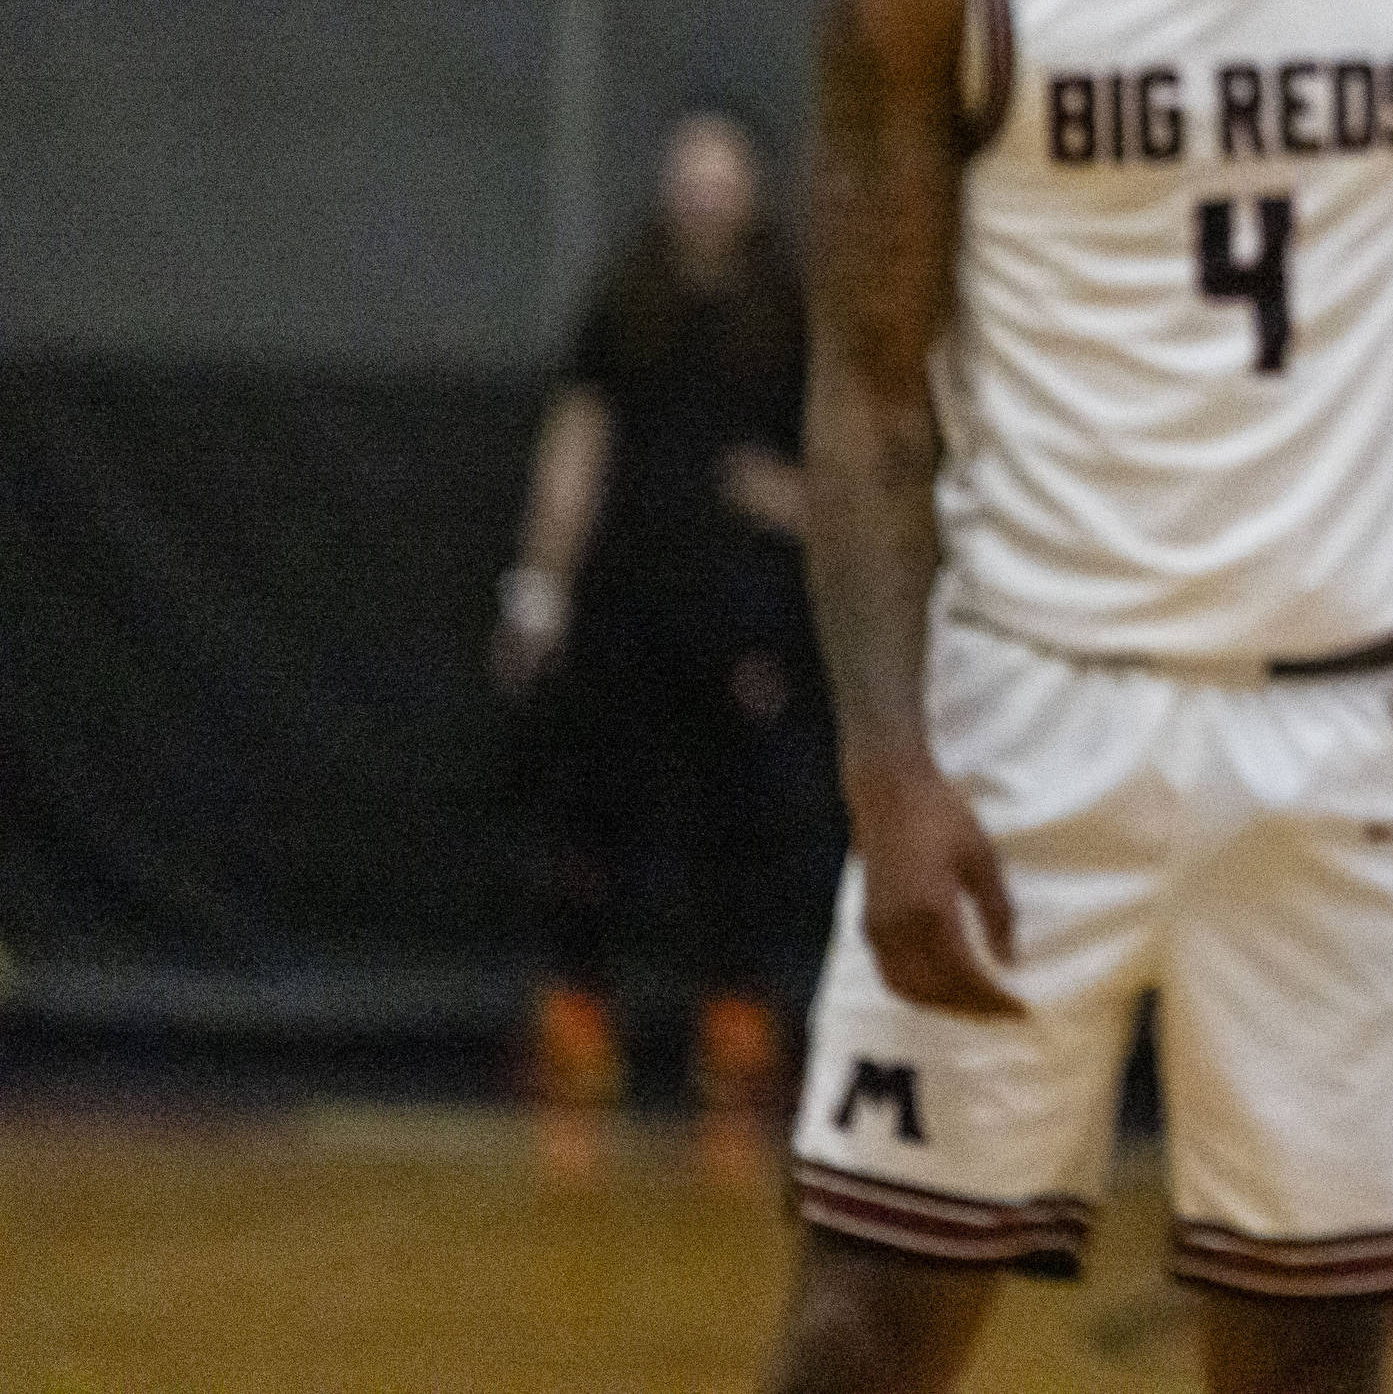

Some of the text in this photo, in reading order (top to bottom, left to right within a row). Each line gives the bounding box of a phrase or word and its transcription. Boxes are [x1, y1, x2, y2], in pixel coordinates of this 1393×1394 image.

[1048, 62, 1186, 165] BIG
[1198, 194, 1293, 376] 4
[833, 1058, 926, 1144] M
